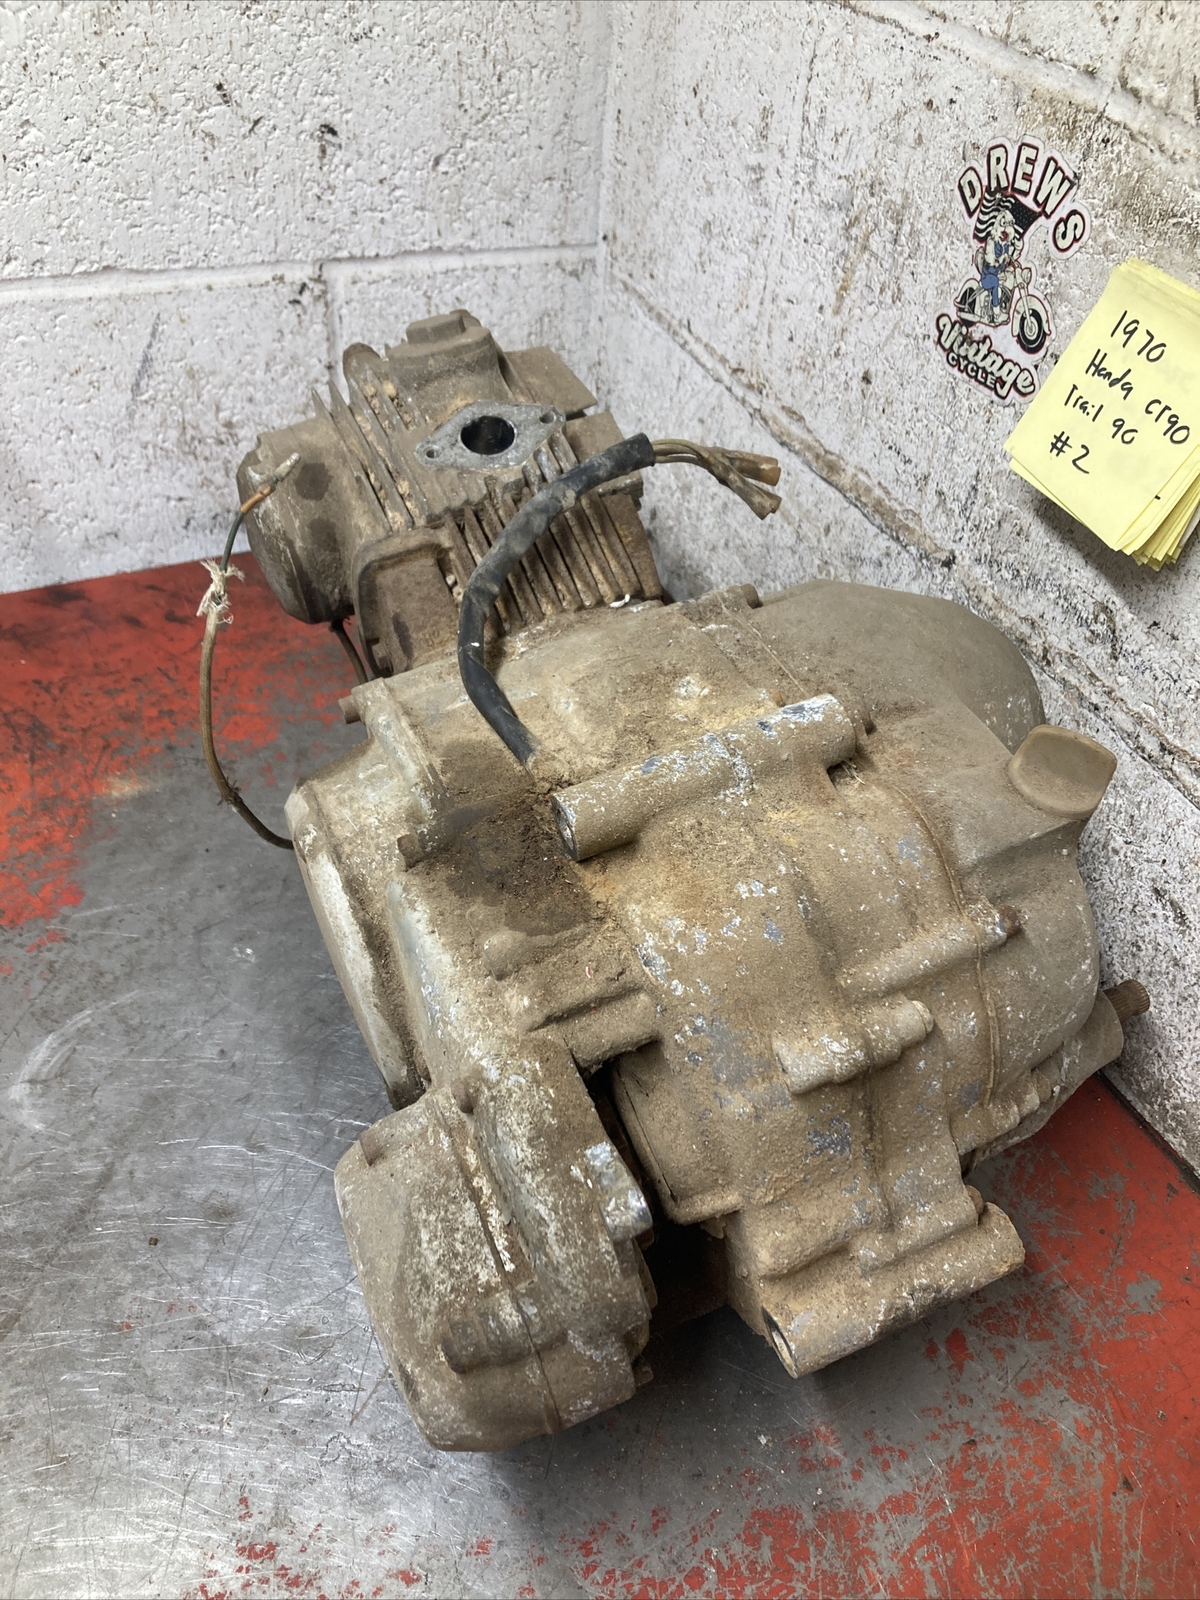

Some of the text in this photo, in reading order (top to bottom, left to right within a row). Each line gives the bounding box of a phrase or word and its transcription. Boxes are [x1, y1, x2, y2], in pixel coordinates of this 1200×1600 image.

[936, 313, 1036, 399] Vintage
[1110, 310, 1167, 363] 1970
[947, 351, 995, 390] CYCLE
[1085, 348, 1134, 401] Honda
[1064, 383, 1139, 445] Trail 90
[1049, 430, 1090, 475] #2
